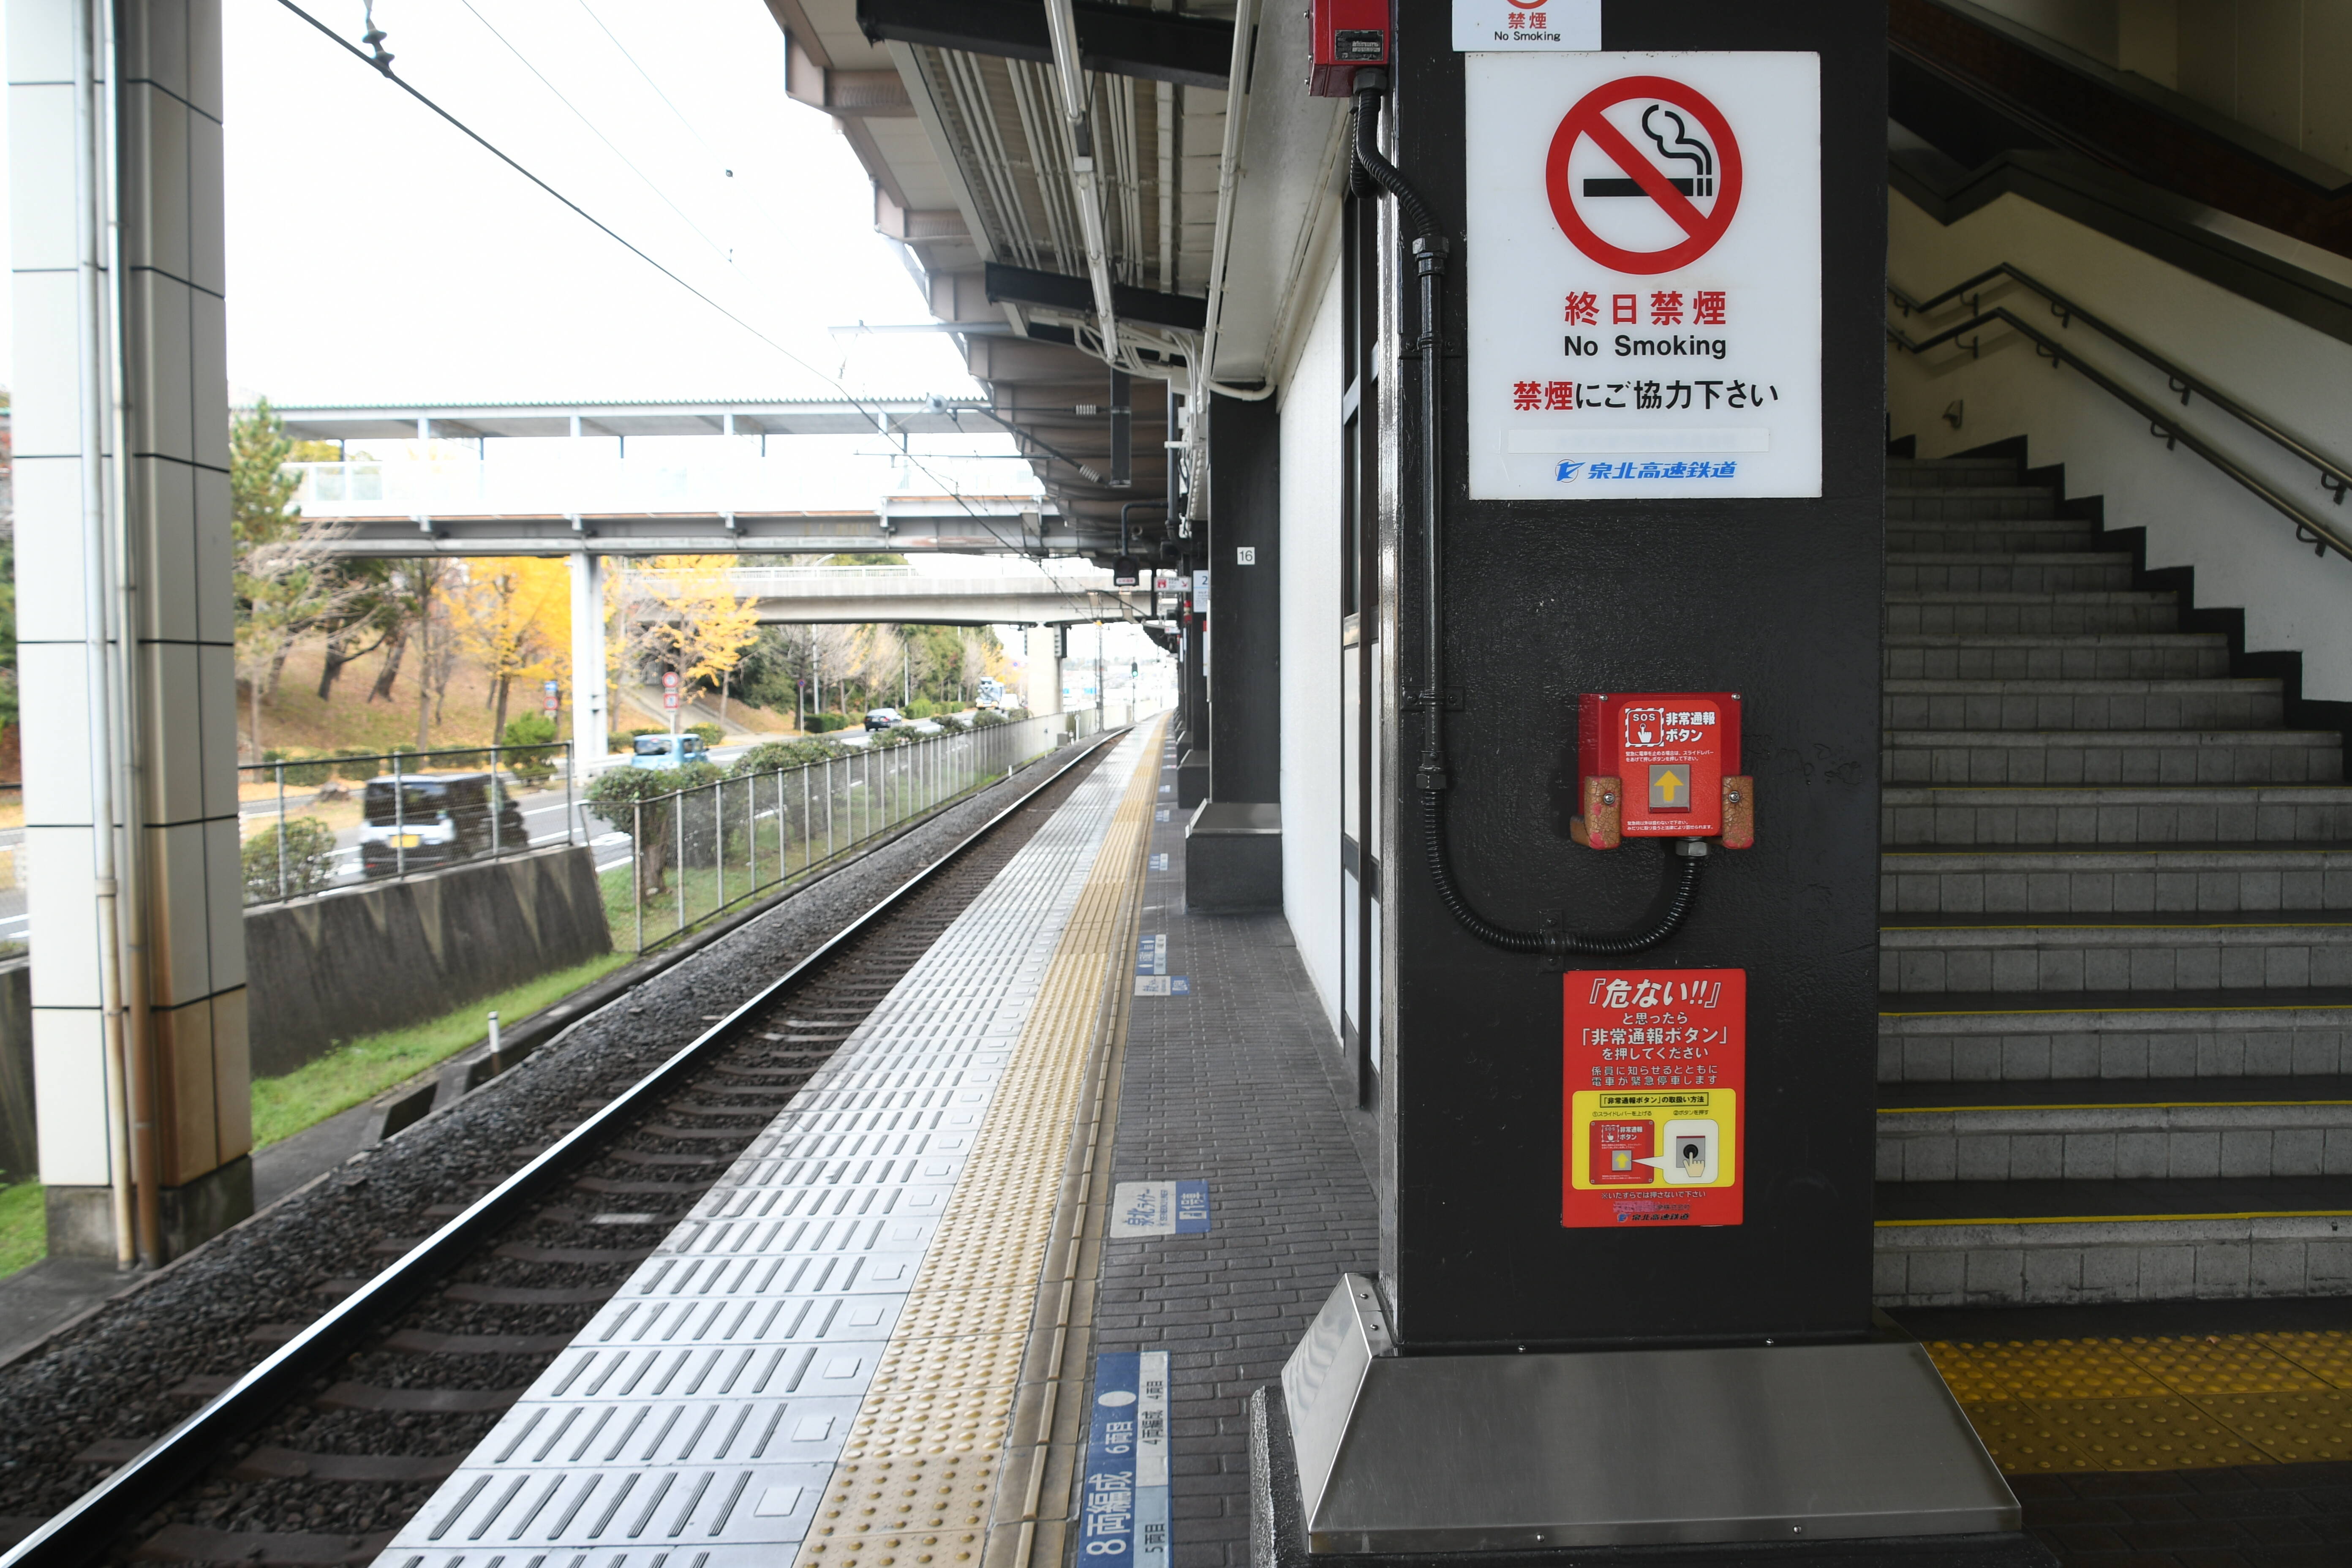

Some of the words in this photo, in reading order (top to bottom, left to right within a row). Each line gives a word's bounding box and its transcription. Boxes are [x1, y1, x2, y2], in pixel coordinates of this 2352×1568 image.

[1508, 12, 1546, 29] 禁煙
[1494, 31, 1508, 40] No
[1514, 31, 1560, 41] Smoking
[1564, 291, 1726, 326] 終日禁煙
[1565, 336, 1598, 356] No
[1614, 335, 1726, 359] Smoking
[1513, 379, 1779, 411] 禁煙にご協力下さい
[1587, 461, 1737, 479] 泉北高速鉄道
[1239, 550, 1253, 561] 16
[1666, 712, 1715, 725] 非常通報
[1666, 729, 1703, 742] ボタン
[1622, 1012, 1688, 1025] と思ったら
[1582, 1026, 1727, 1046] 「非常通報ボタン」
[1602, 1047, 1709, 1061] を押してください
[1591, 1065, 1718, 1076] 係員に知らせるとともに
[1591, 1075, 1718, 1086] 電車が緊急停車します
[1604, 1096, 1704, 1105] 「非常通報ボタン」の取扱い方法
[1122, 1189, 1155, 1227] 泉北ライナー
[1146, 1380, 1163, 1399] 4両目
[1141, 1410, 1164, 1445] 4両編成
[1105, 1421, 1133, 1454] 6両目
[1086, 1471, 1132, 1555] 8両編成
[1144, 1523, 1165, 1554] 5両目
